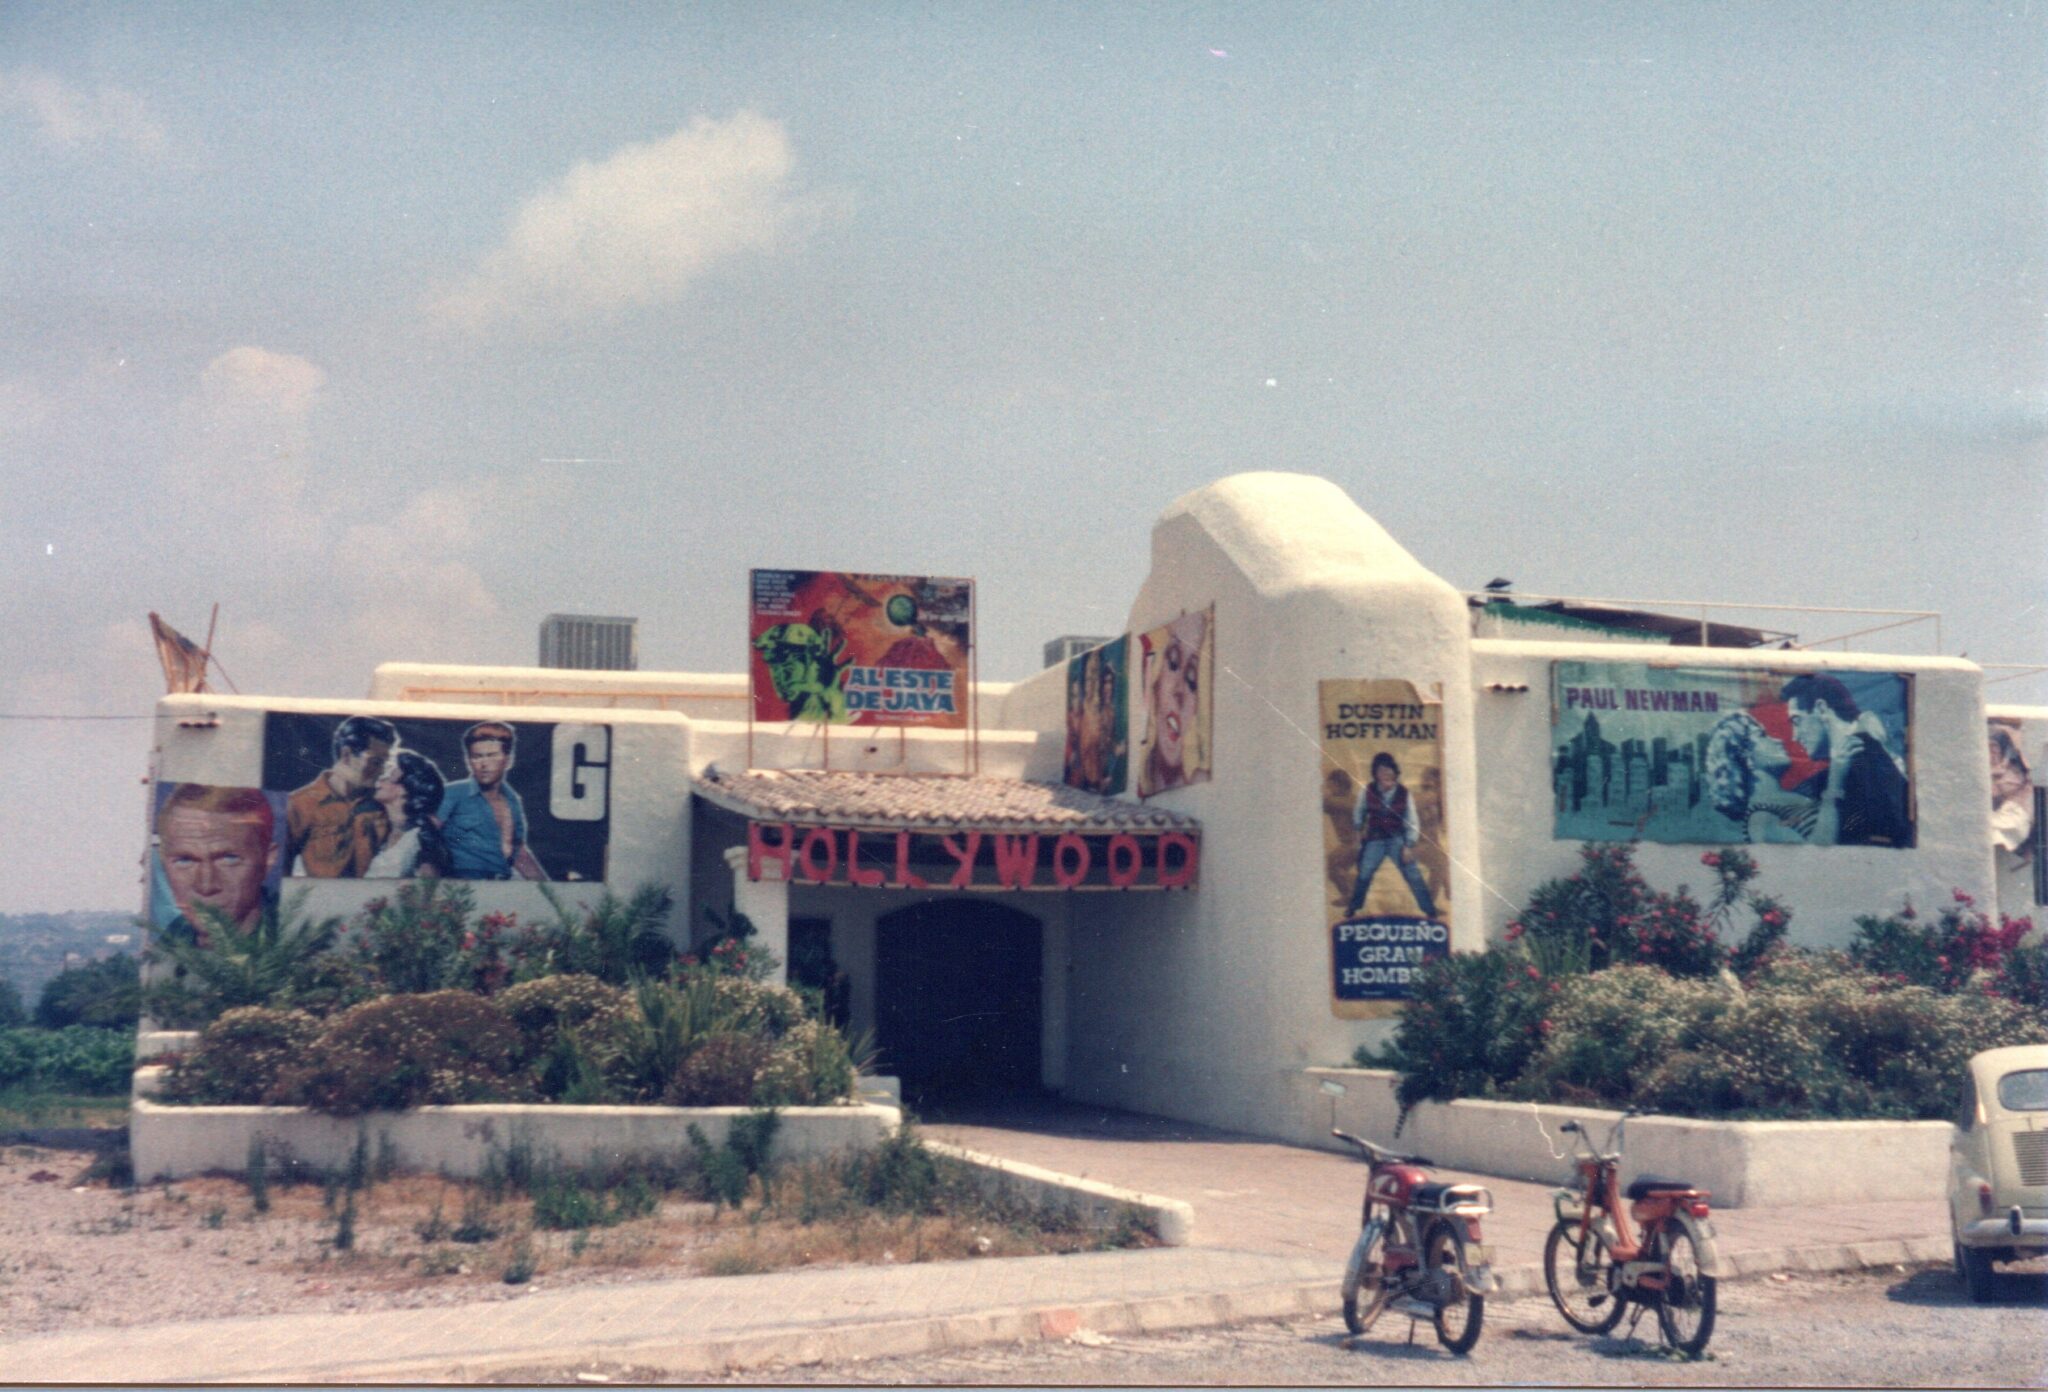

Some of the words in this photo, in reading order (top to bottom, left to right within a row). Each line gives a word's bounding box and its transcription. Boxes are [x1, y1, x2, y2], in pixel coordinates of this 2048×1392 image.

[849, 667, 880, 687] AL
[885, 668, 956, 690] ESTE
[846, 691, 881, 710] DE
[1566, 687, 1619, 711] PAUL
[1625, 688, 1719, 713] NEWMAN
[1338, 703, 1424, 721] DUSTIN
[1325, 723, 1437, 740] HOFFMAN
[550, 723, 607, 820] G
[749, 823, 1198, 888] HOLLYWOOD
[1339, 921, 1448, 943] PEQUEÑO
